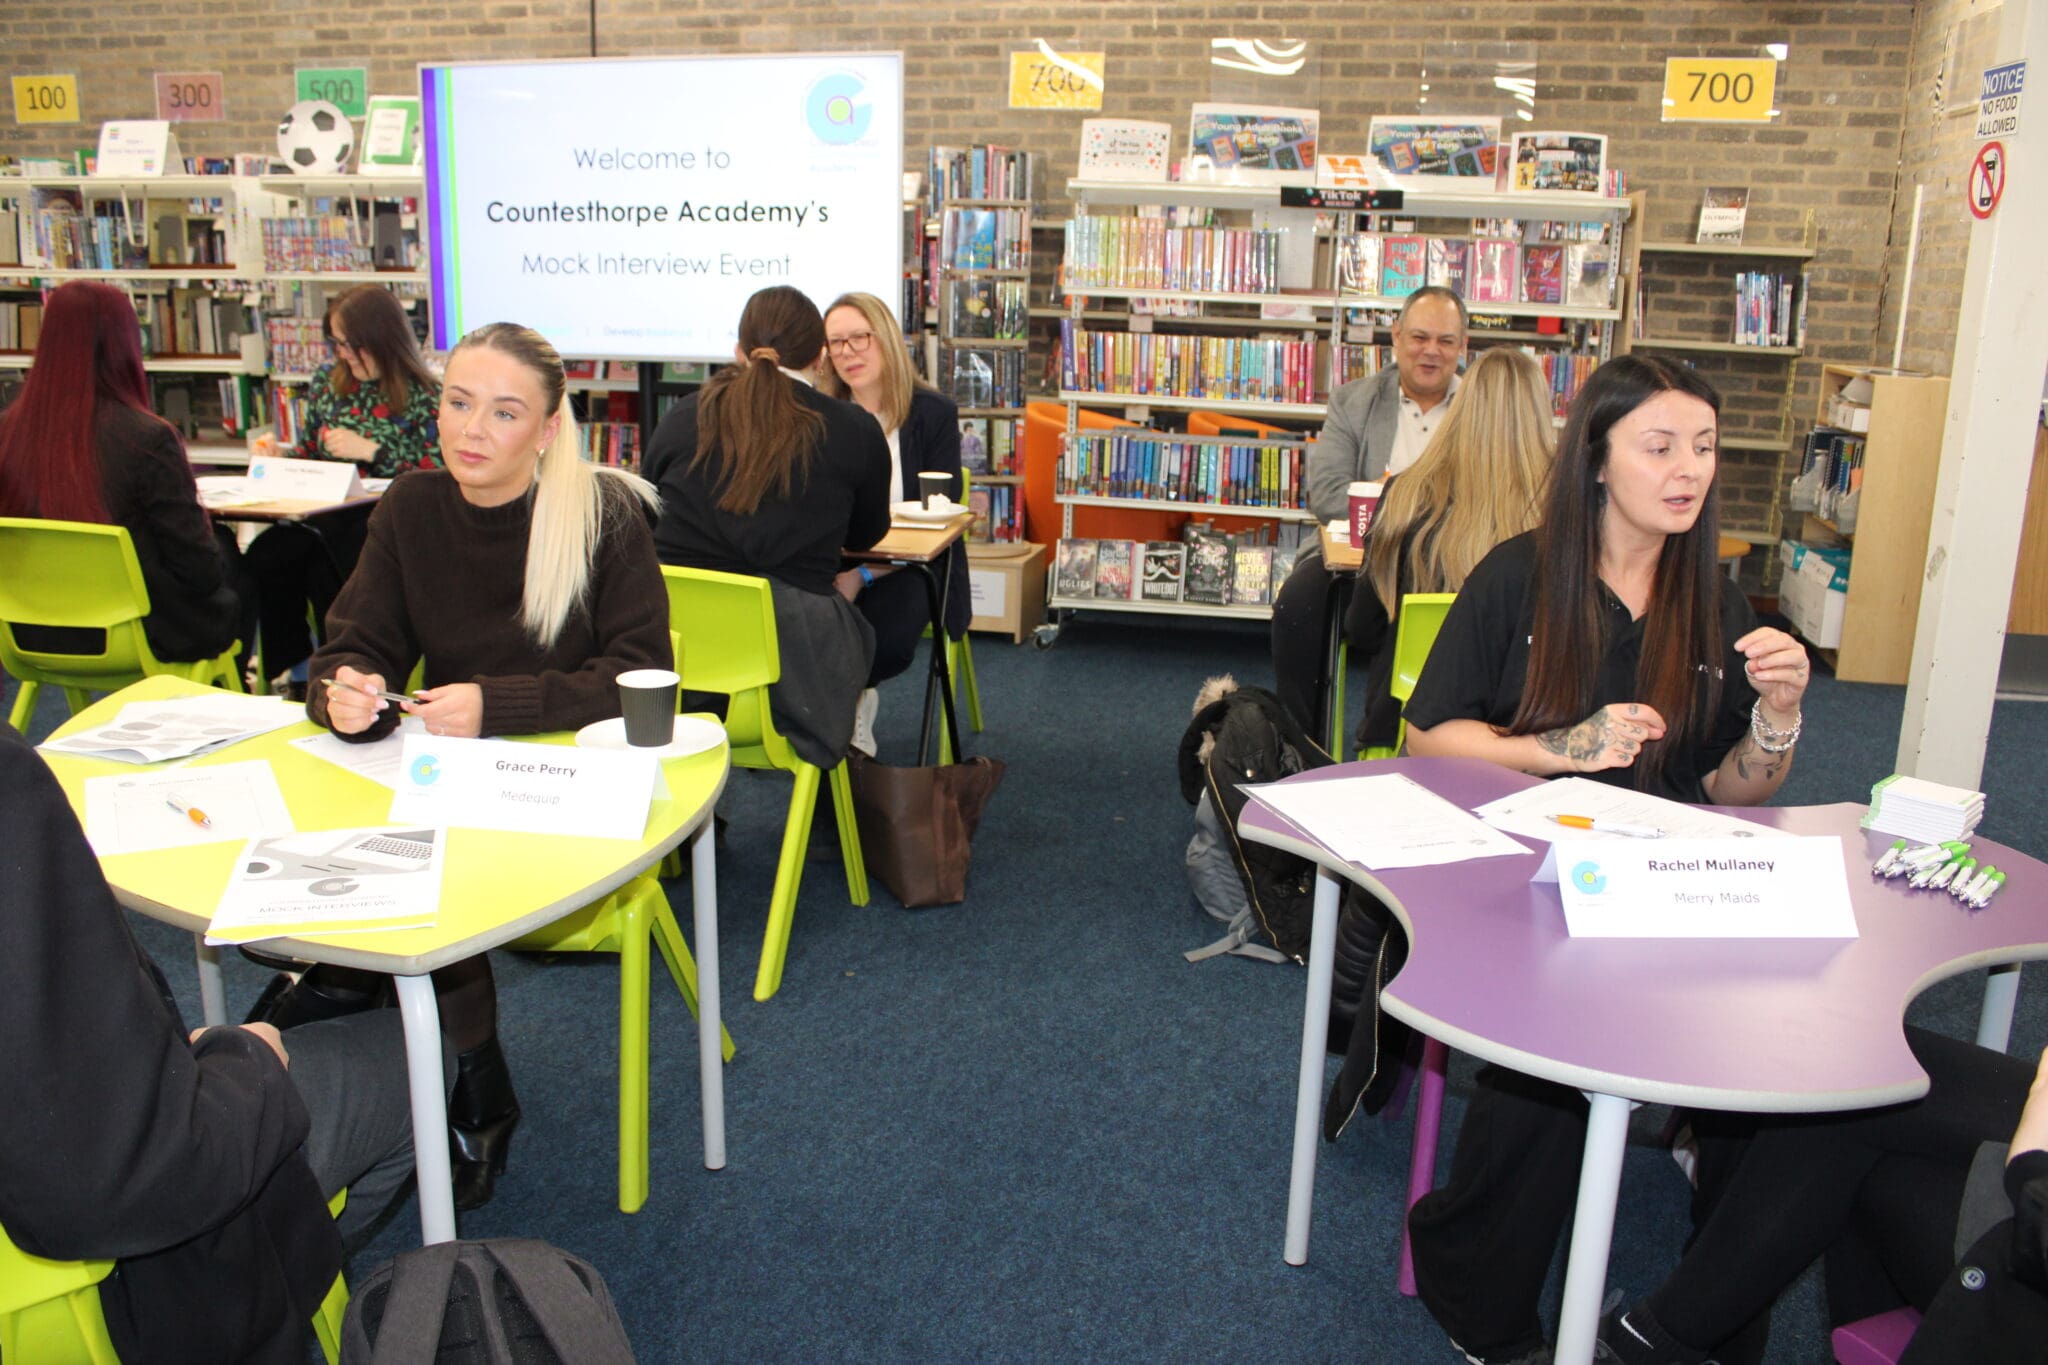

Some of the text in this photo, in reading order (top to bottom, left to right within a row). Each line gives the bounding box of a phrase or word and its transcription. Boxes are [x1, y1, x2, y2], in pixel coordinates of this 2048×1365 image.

[1686, 71, 1755, 104] 700
[1982, 67, 2025, 96] NOTICE
[27, 85, 67, 110] 100
[169, 83, 212, 108] 300
[309, 79, 354, 105] 500
[1981, 95, 2018, 116] NO FOOD
[1977, 116, 2017, 136] ALLOWED
[1391, 130, 1421, 140] Young
[1432, 141, 1460, 150] Teens
[573, 146, 731, 170] Welcome to
[1319, 189, 1362, 201] TikTok
[486, 199, 830, 227] Countesthorpe Academy's
[1391, 242, 1420, 254] FIND
[521, 253, 791, 276] Mock Interview Event
[1393, 258, 1409, 273] ME
[1386, 278, 1420, 289] AFTER
[1357, 503, 1368, 538] COSTA
[1234, 551, 1265, 564] NEVER
[1237, 564, 1268, 576] NEVER
[1144, 581, 1179, 595] WHITEOUT
[495, 760, 578, 779] Grace Perry
[500, 790, 561, 806] Medequip
[1648, 859, 1775, 874] Rachel Mullaney
[1674, 891, 1760, 906] Merry Maids
[259, 900, 397, 914] MOCK INTERVIEWS
